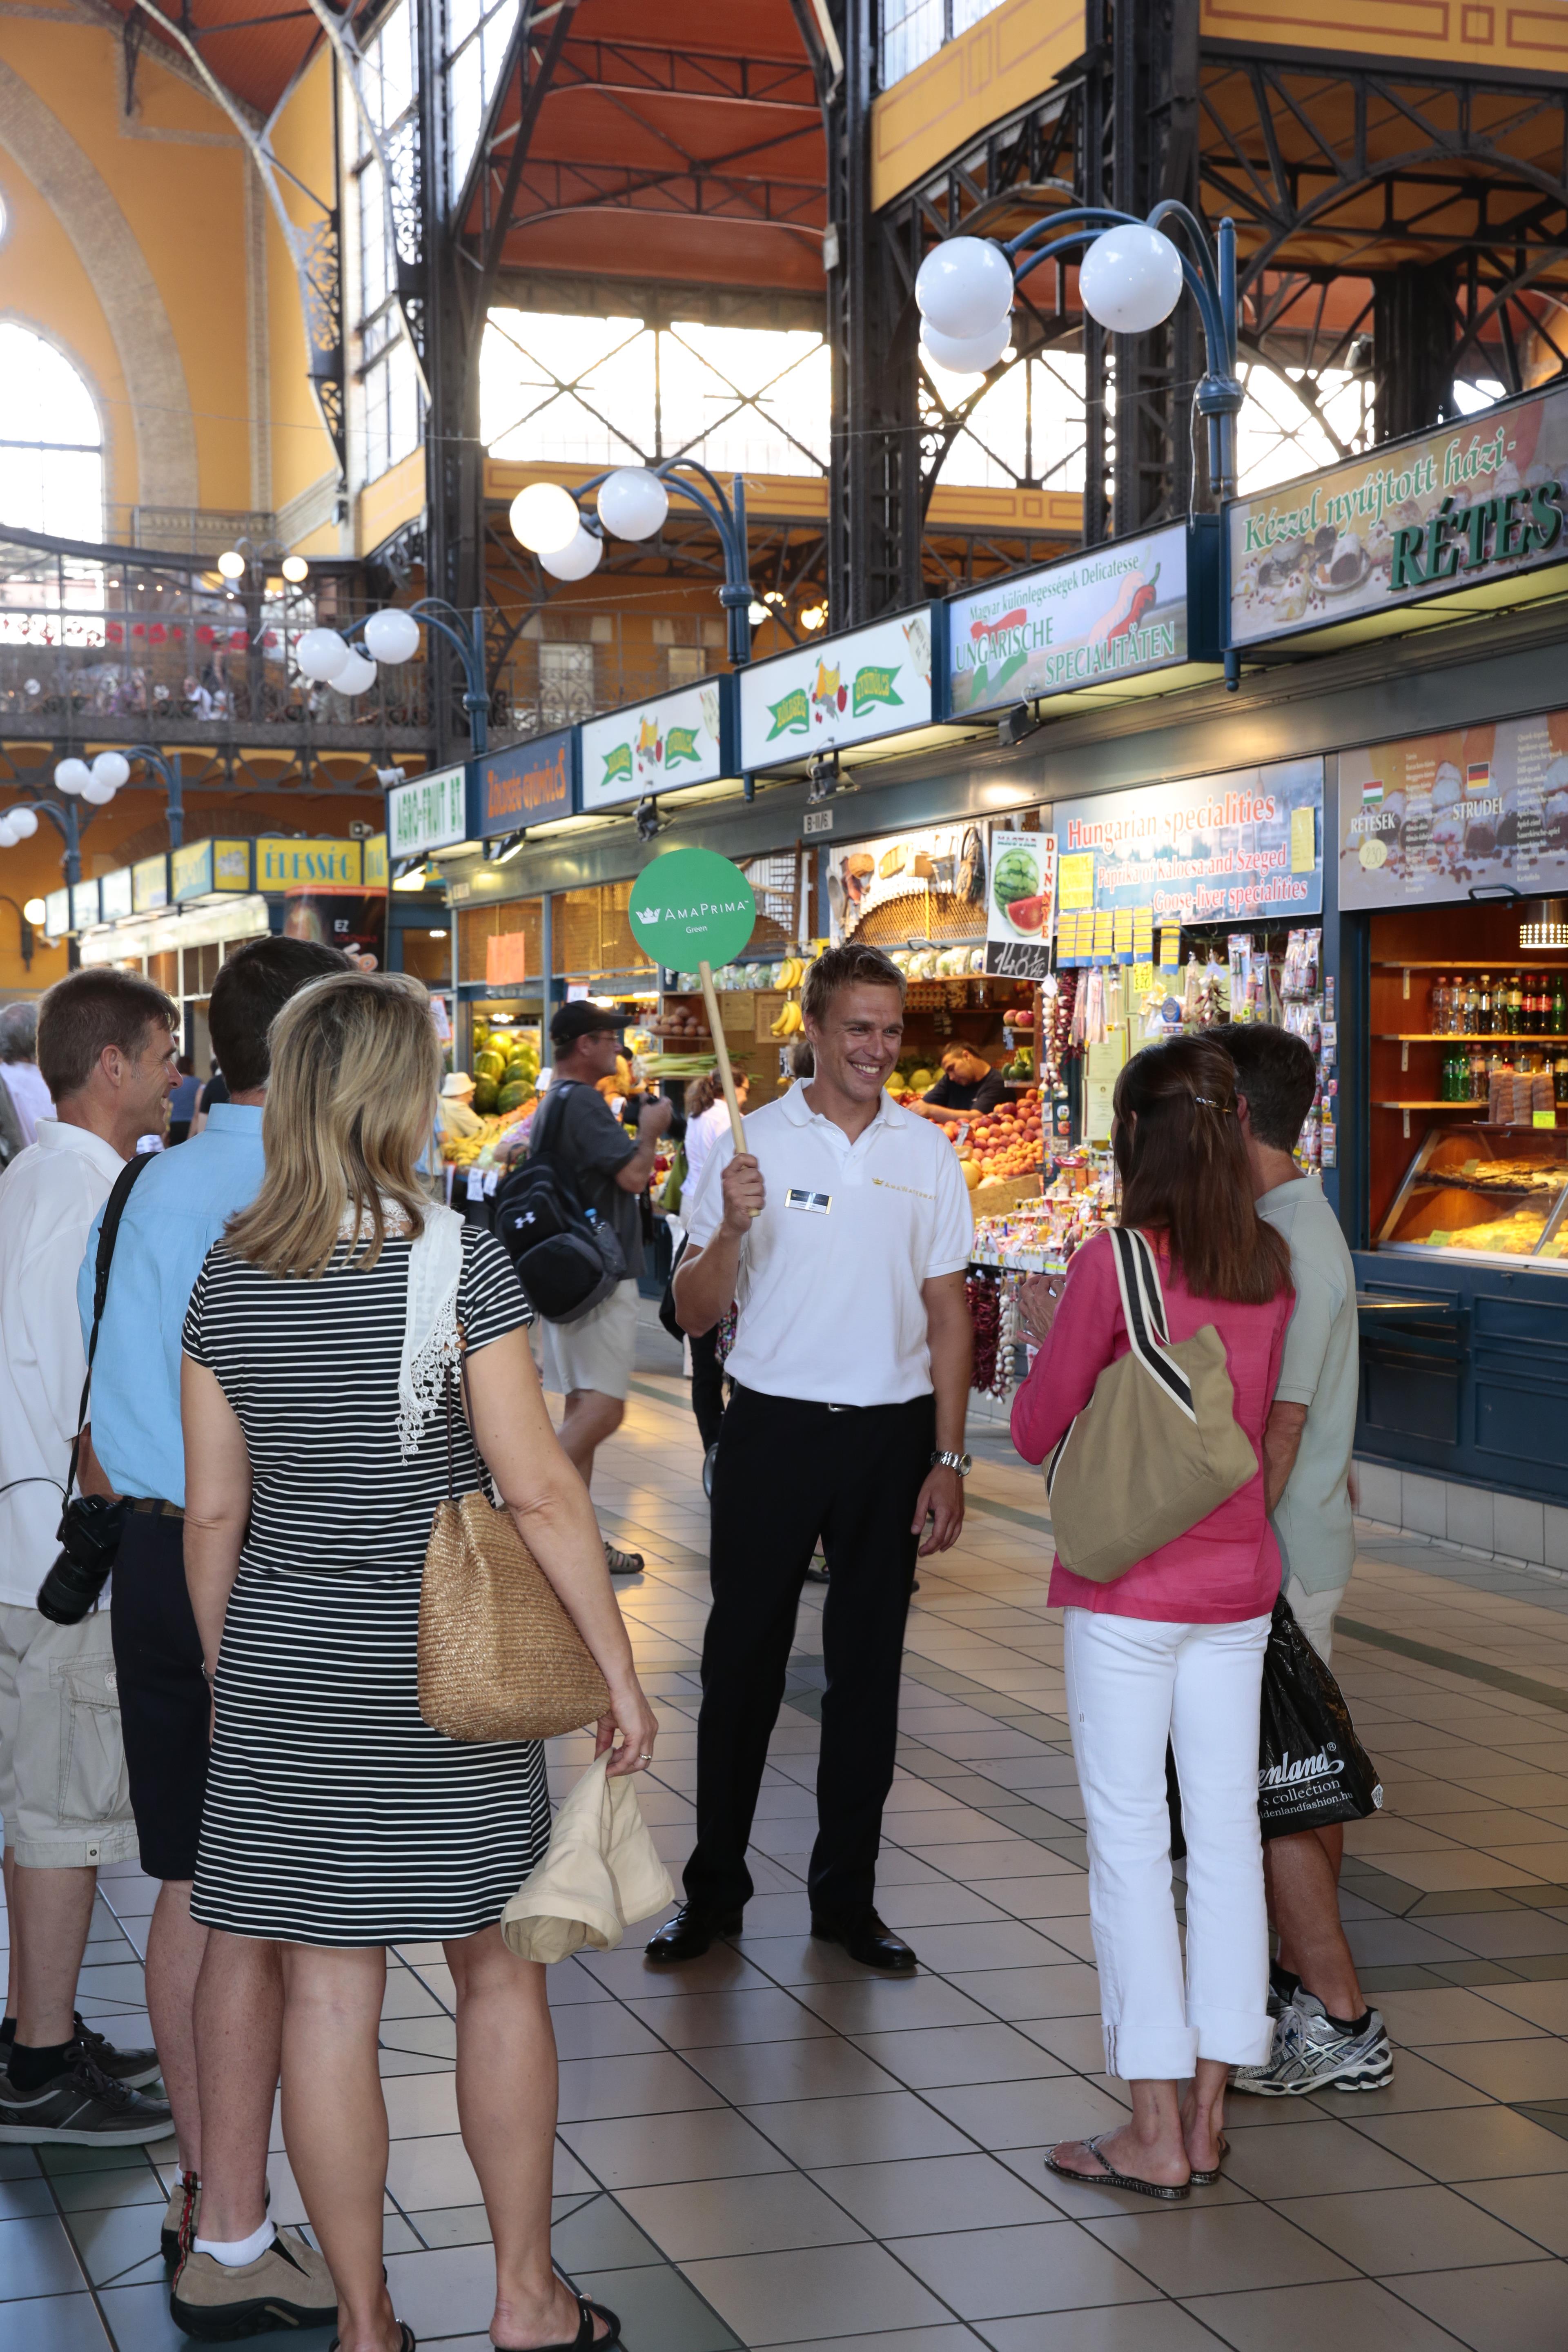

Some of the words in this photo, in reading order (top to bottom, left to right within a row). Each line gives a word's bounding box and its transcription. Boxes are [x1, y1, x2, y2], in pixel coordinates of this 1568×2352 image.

[1241, 487, 1322, 555] Kézzel
[1325, 457, 1437, 540] nyújtott
[1441, 426, 1517, 488] házi-
[1387, 479, 1563, 592] RÉTES
[969, 601, 1000, 625] Magyar
[1002, 572, 1079, 608] különlegességek
[1081, 555, 1139, 586] Delicatesse
[955, 617, 1054, 673] UNGARISCHE
[1044, 621, 1175, 687] SPECIALITÄTEN
[1067, 810, 1157, 851] Hungarian
[1164, 789, 1276, 841] specialities
[1351, 812, 1396, 834] RÉTESEK
[1452, 797, 1505, 821] STRUDEL
[265, 843, 354, 881] ÉDESSÉG
[1098, 862, 1141, 893] Paprika
[1157, 855, 1205, 880] Kalocsa
[1207, 849, 1233, 874] and
[1236, 842, 1287, 877] Szeged
[1041, 837, 1055, 939] DINNYE
[1153, 884, 1226, 913] Goose-liver
[1228, 879, 1307, 913] specialities
[334, 919, 349, 932] EZ
[686, 925, 708, 933] Green
[1273, 1780, 1341, 1805] collection
